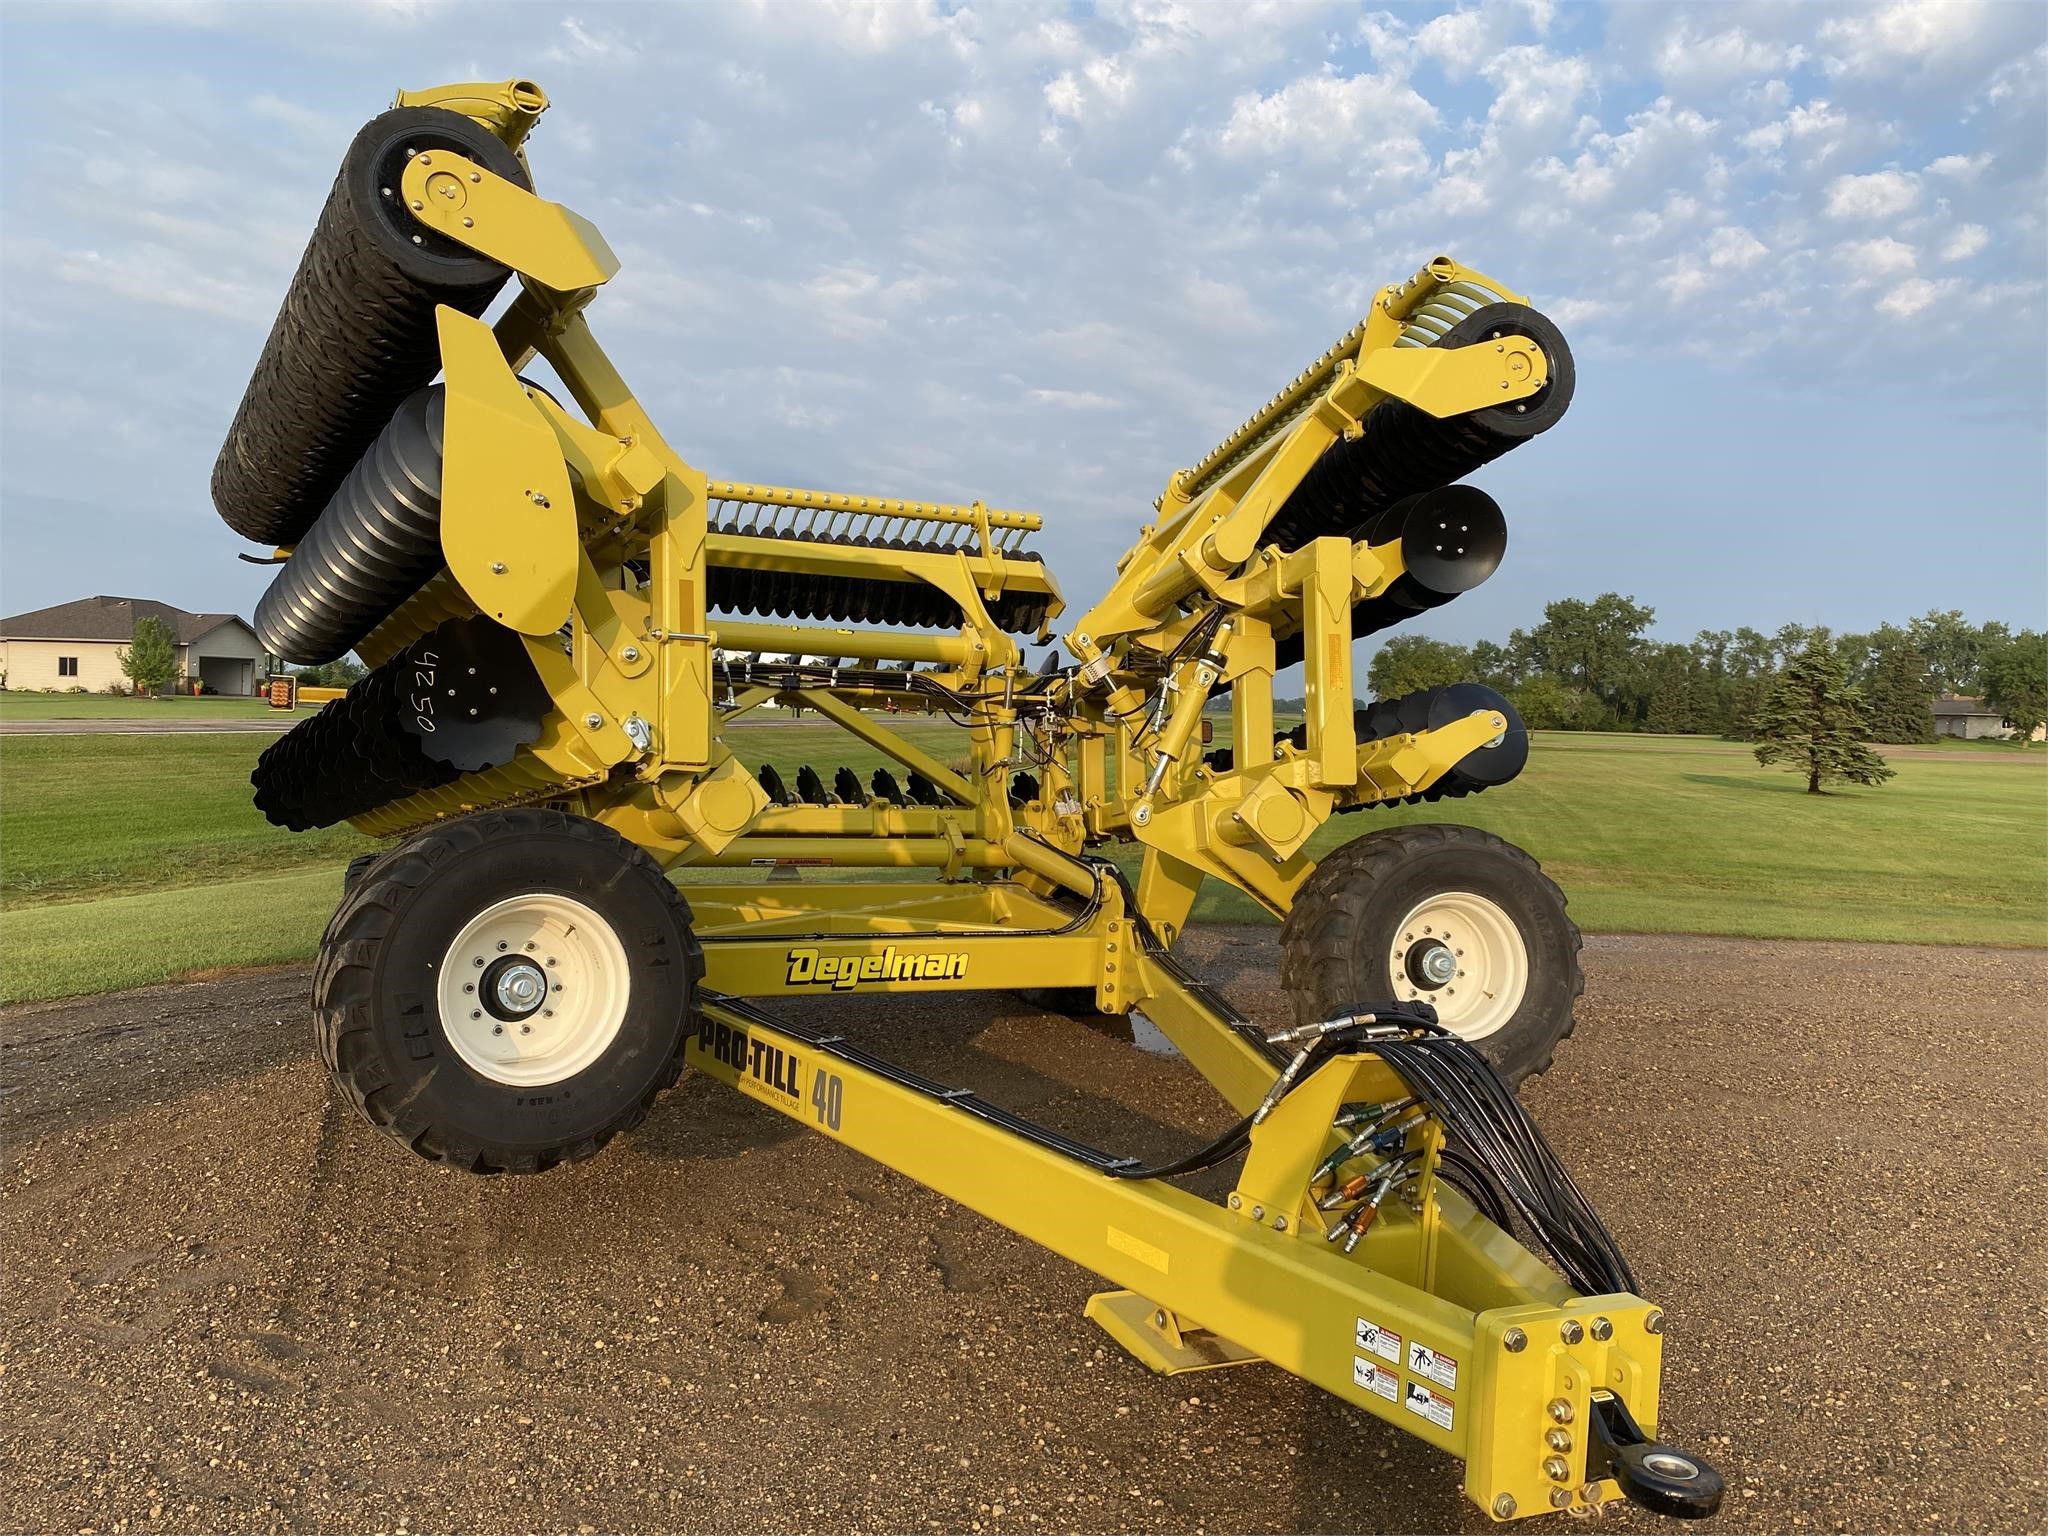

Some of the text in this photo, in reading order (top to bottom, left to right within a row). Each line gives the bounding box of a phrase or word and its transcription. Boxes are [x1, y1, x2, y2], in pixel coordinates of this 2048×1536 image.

[410, 651, 439, 733] 4250
[785, 946, 970, 991] Degelman
[746, 1078, 780, 1101] PERFORMANCE
[779, 1092, 800, 1113] TILLAGE
[811, 1068, 843, 1132] 40
